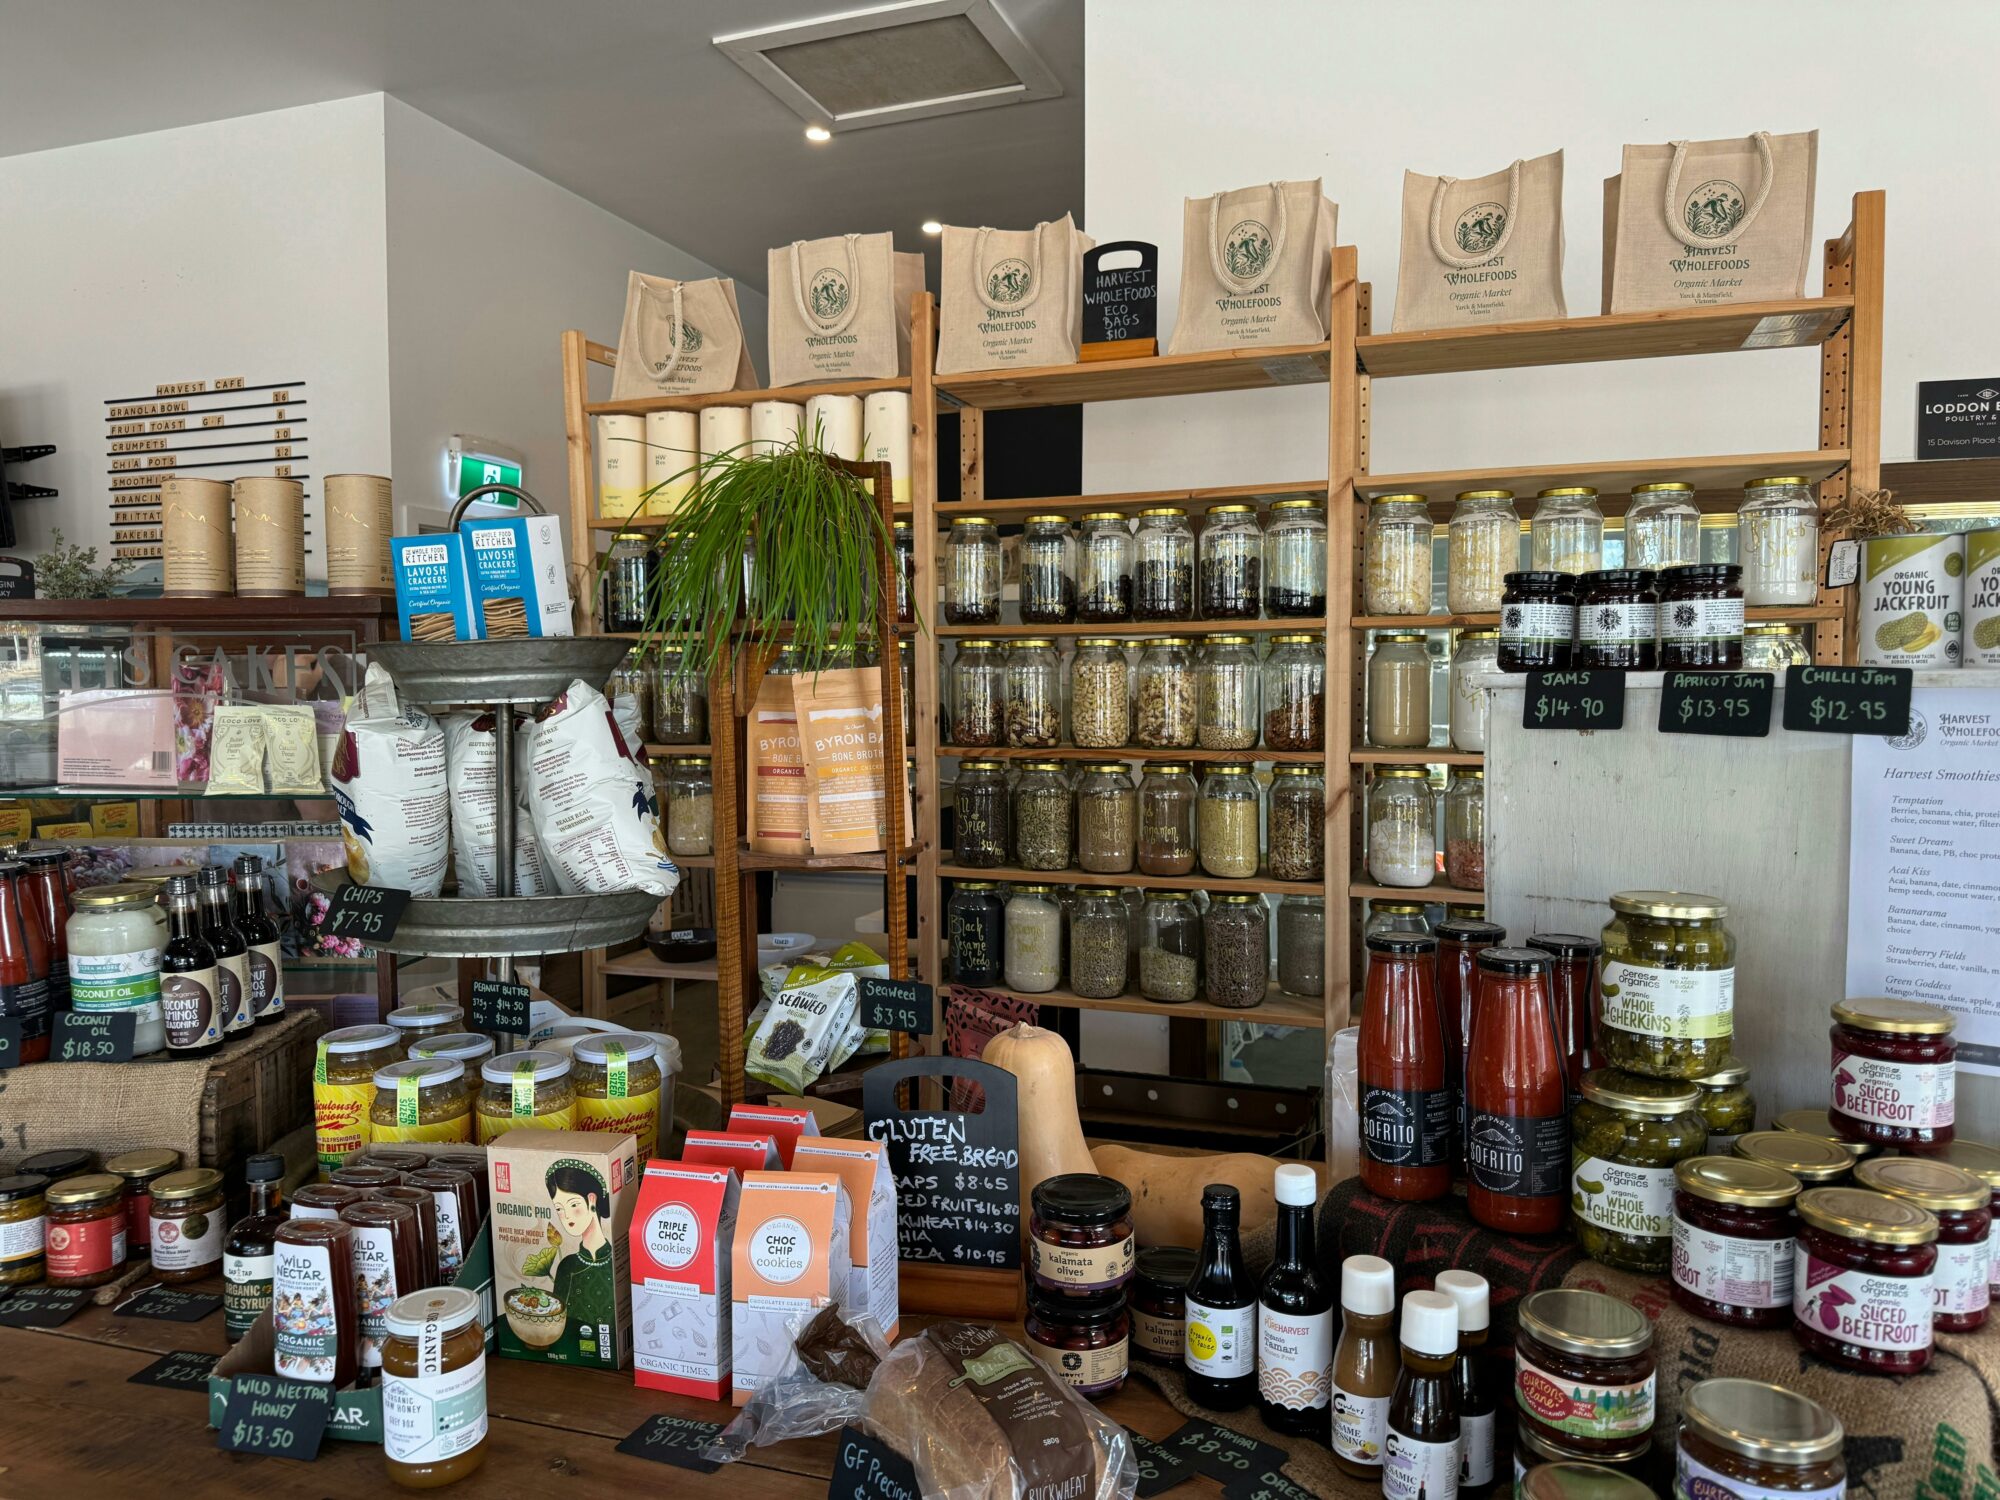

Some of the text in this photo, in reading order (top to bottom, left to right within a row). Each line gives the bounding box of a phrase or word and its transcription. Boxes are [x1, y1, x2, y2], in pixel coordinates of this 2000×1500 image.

[1669, 260, 1750, 272] WHOLEFOODS
[1097, 270, 1149, 288] HARVEST
[1444, 270, 1517, 285] WHOLEFOODS
[1674, 278, 1742, 289] Organic Market
[1084, 285, 1157, 305] WHOLEFOODS
[1450, 289, 1511, 301] Organic Market
[1105, 305, 1128, 315] ECO
[1215, 296, 1281, 312] WHOLEFOODS
[978, 320, 1037, 335] WHOLEFOODS
[1103, 315, 1139, 329] BAGS
[806, 334, 858, 348] WHOLEFOODS
[1107, 327, 1127, 340] $10
[156, 379, 242, 394] HARVEST CAFE
[110, 393, 286, 416] GRANOLA BOWL 16
[1926, 402, 1989, 414] LODDON
[111, 421, 183, 434] FRUIT TOAST
[112, 441, 165, 451] CRUMPETS
[113, 448, 289, 469] CHIA POTS 12
[116, 531, 155, 539] BAKERS
[475, 538, 513, 547] KITCHEN
[405, 554, 445, 563] KITCHEN
[478, 551, 515, 561] LAVOSH
[408, 566, 446, 577] LAVOSH
[479, 560, 516, 569] CRACKERS
[408, 576, 447, 585] CRACKERS
[1895, 571, 1928, 580] ORGANIC
[1883, 580, 1935, 595] YOUNG
[1874, 595, 1949, 611] JACKFRUIT
[170, 645, 346, 710] CAKES
[1542, 671, 1590, 686] JAMS
[1673, 673, 1765, 690] APRICOT JAM
[1801, 667, 1897, 686] CHILLI JAM
[1678, 698, 1750, 724] $13.95
[1809, 700, 1887, 725] $12.95
[1939, 713, 1991, 725] HARVEST
[815, 732, 864, 752] BYRON
[772, 754, 794, 763] BONE
[832, 750, 883, 761] BONE BROTH
[1883, 768, 1933, 780] Harvest
[1892, 795, 1943, 807] Temptation
[958, 819, 986, 836] Spice
[1890, 835, 1954, 847] Sweet Dreams
[343, 886, 384, 903] CHIPS
[1888, 905, 1947, 918] Bananarama
[333, 910, 384, 933] $7.95
[951, 915, 983, 941] Black
[1941, 922, 1983, 932] cinnamon,
[952, 937, 986, 958] Sesame
[1886, 945, 1966, 961] Strawberry Fields
[1886, 957, 1989, 974] Strawberries, vanilla,
[1618, 975, 1660, 989] Organics
[1622, 969, 1649, 981] Ceres
[1885, 975, 1952, 990] Green Goddess
[74, 988, 134, 998] COCONUT OIL
[473, 981, 530, 997] PEANUT BUTTER
[866, 980, 916, 1002] Seaweed
[1625, 991, 1650, 1000] organic
[162, 998, 200, 1010] COCONUT
[778, 994, 827, 1016] SEAWEED
[1621, 997, 1655, 1014] WHOLE
[65, 1015, 113, 1027] COCONUT
[873, 1004, 917, 1028] $3.95
[92, 1026, 111, 1036] OIL
[62, 1038, 114, 1059] $18.50
[1858, 1067, 1902, 1081] Organics
[1862, 1061, 1892, 1073] Ceres
[609, 1069, 617, 1095] SIZED
[617, 1070, 627, 1097] SUPER
[1864, 1078, 1894, 1088] organic
[406, 1096, 417, 1126] SUPER
[1846, 1095, 1915, 1122] BEETROOT
[868, 1115, 966, 1145] GLUTEN
[1364, 1117, 1414, 1144] SOFRITO
[327, 1141, 361, 1152] BUTTER
[909, 1144, 1019, 1169] FREE BREAD
[1470, 1142, 1522, 1173] SOFRITO
[1602, 1173, 1649, 1188] Organics
[1607, 1167, 1637, 1180] Ceres
[955, 1172, 1008, 1191] $8.65
[1611, 1189, 1638, 1199] organic
[497, 1202, 551, 1219] ORGANIC PHO
[931, 1196, 977, 1212] FRUIT
[1606, 1195, 1644, 1214] WHOLE
[498, 1227, 512, 1235] WHITE
[525, 1229, 544, 1237] NOODLE
[658, 1220, 687, 1232] TRIPLE
[658, 1231, 685, 1241] CHOC
[766, 1236, 796, 1245] CHOC
[650, 1242, 692, 1255] cookies
[767, 1245, 793, 1255] CHIP
[280, 1254, 312, 1270] WILD
[756, 1257, 802, 1269] cookies
[1049, 1252, 1093, 1266] kalamata
[277, 1265, 325, 1281] NECTAR
[1057, 1266, 1084, 1277] olives
[1866, 1278, 1899, 1290] Ceres
[1860, 1286, 1909, 1298] Organics
[1867, 1298, 1901, 1307] organic
[1842, 1317, 1919, 1344] BEETROOT
[278, 1333, 325, 1347] ORGANIC
[1153, 1336, 1180, 1347] olives
[1264, 1337, 1298, 1354] Tamari
[640, 1358, 679, 1372] ORGANIC
[236, 1379, 329, 1400] WILD NECTAR
[251, 1400, 296, 1418] HONEY
[656, 1416, 720, 1434] COOKIES
[232, 1420, 294, 1448] $13.50
[1211, 1426, 1258, 1450] TAMARI
[1043, 1438, 1059, 1446] 580g
[844, 1442, 868, 1470] GF
[1131, 1435, 1183, 1466] SOY SAUCE
[1179, 1433, 1250, 1470] $8.50
